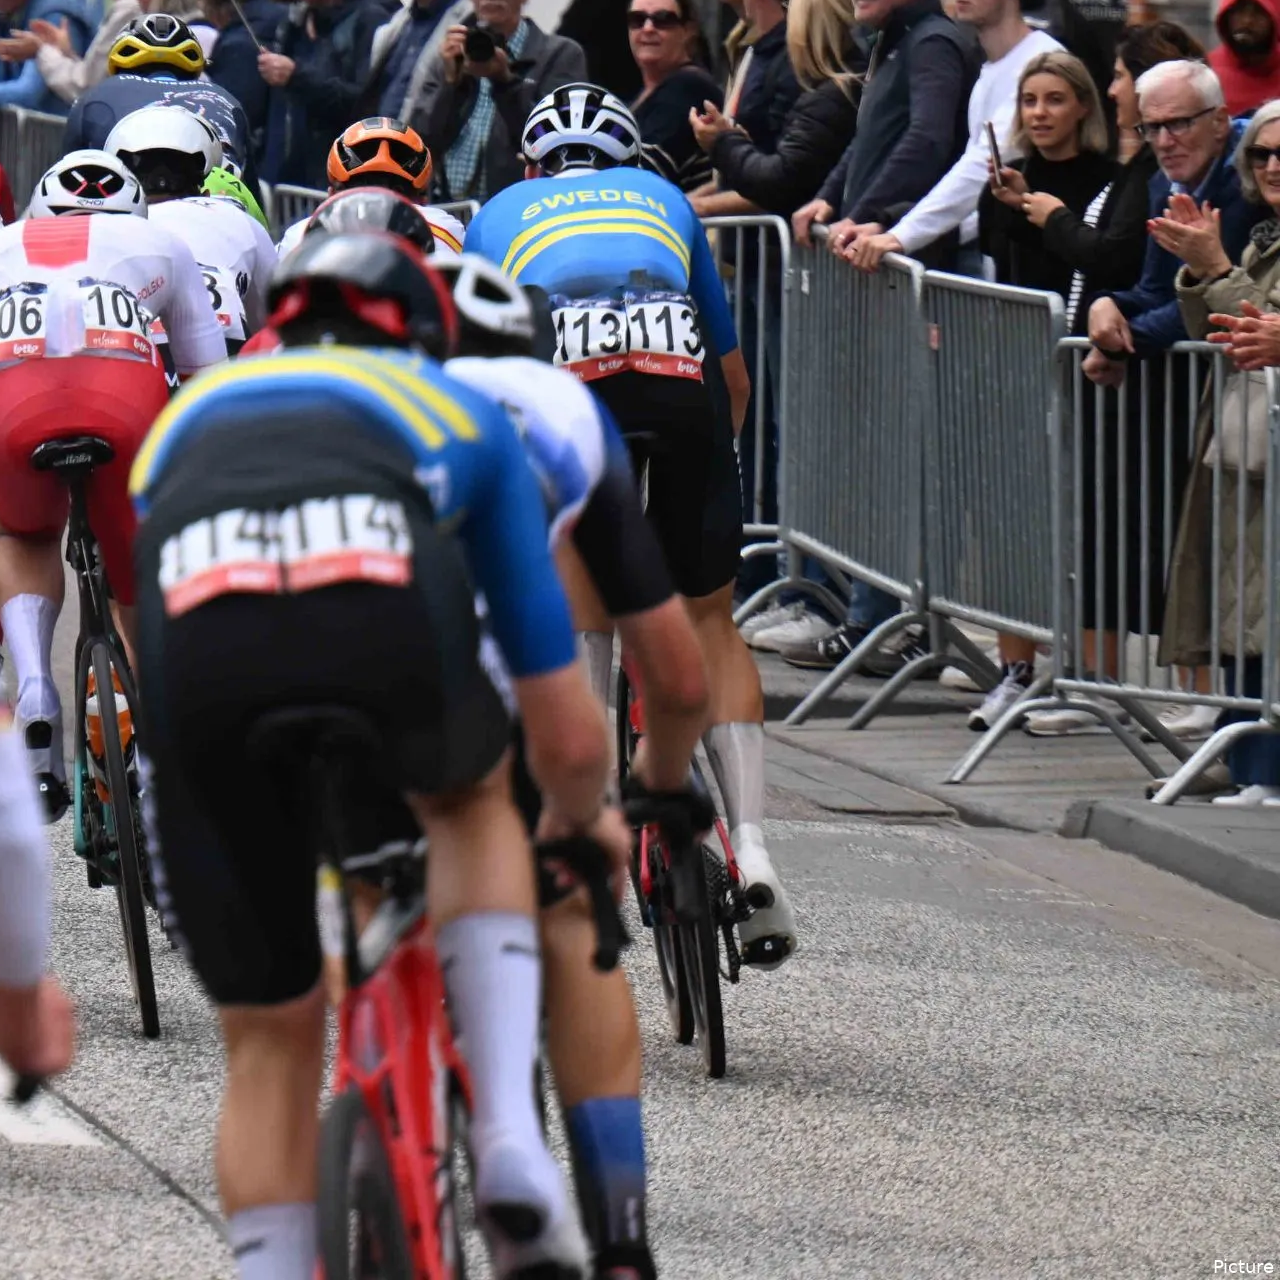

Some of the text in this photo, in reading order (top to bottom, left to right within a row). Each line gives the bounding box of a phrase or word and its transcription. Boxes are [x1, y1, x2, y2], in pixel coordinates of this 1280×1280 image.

[521, 189, 668, 220] SWEDEN
[556, 305, 702, 362] 113 113
[13, 342, 40, 356] lotto
[598, 354, 699, 375] lotto ethias lotto
